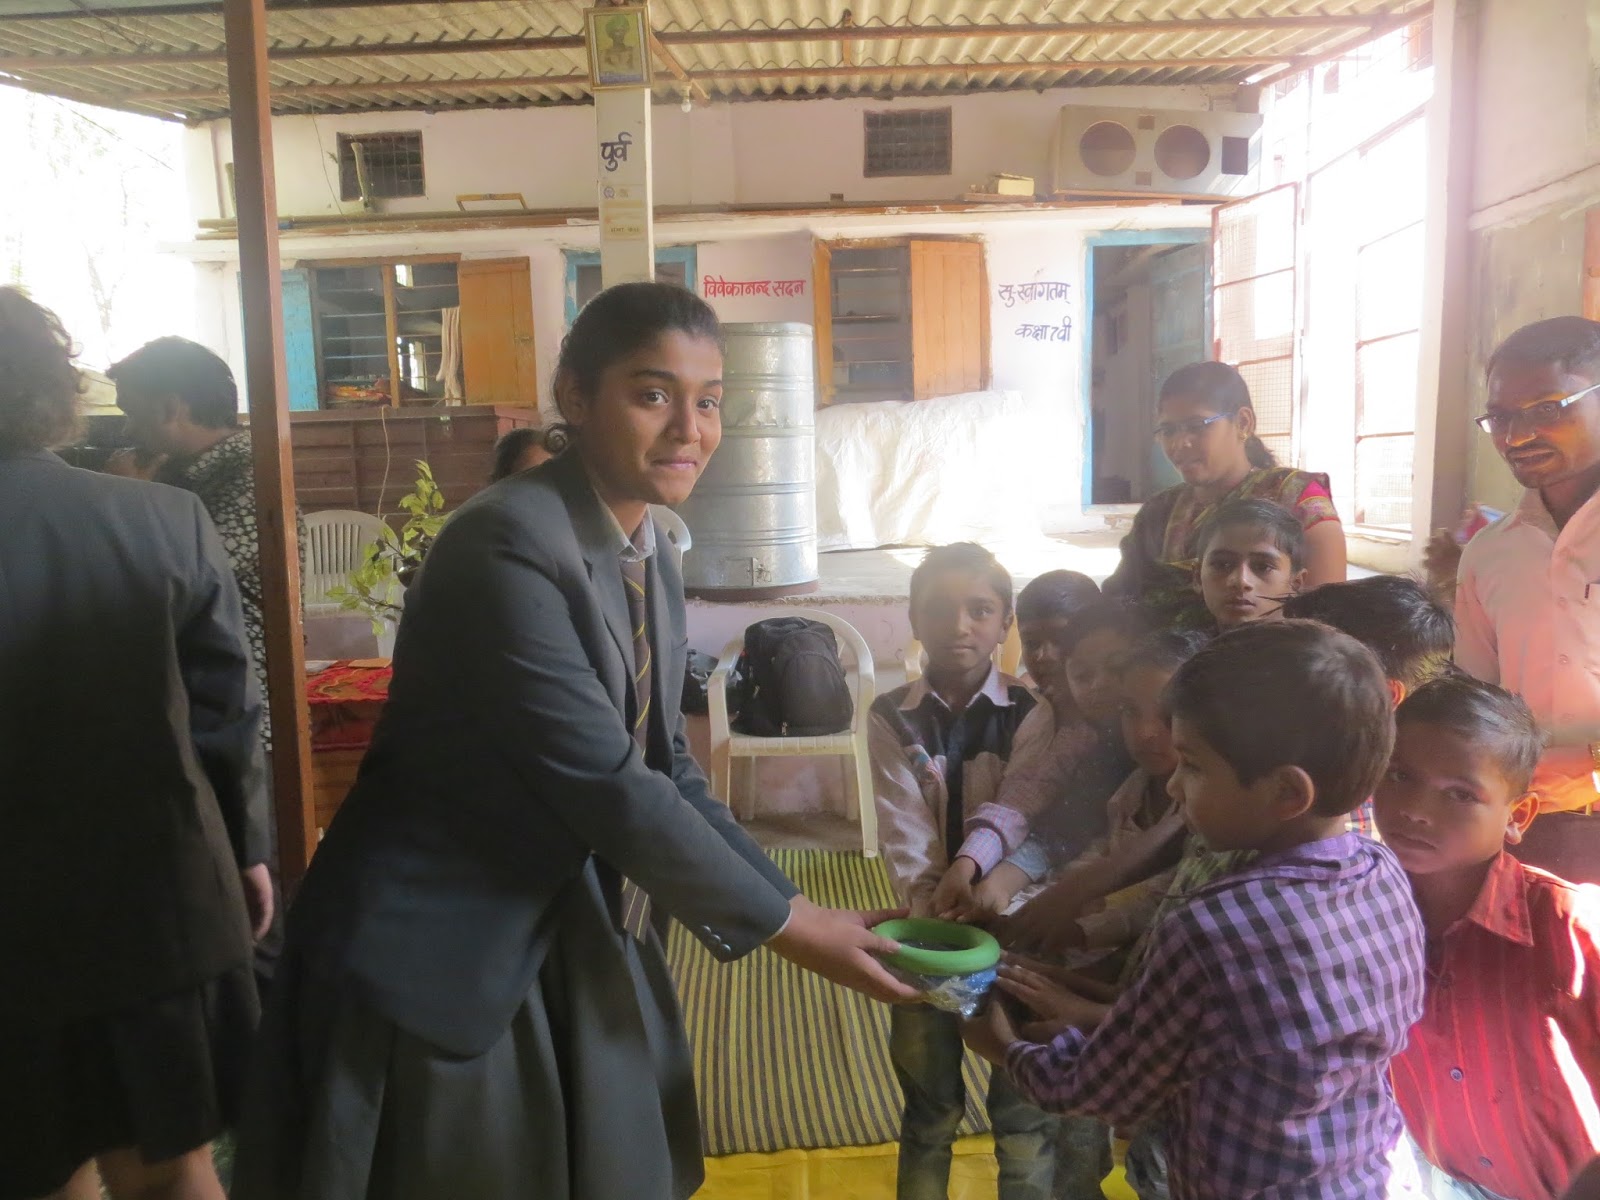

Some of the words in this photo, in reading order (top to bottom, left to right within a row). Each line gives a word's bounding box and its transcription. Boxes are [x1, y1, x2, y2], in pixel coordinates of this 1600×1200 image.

[703, 275, 771, 298] विवेकानन्द
[772, 279, 807, 297] सदन
[1014, 323, 1050, 341] कक्षा
